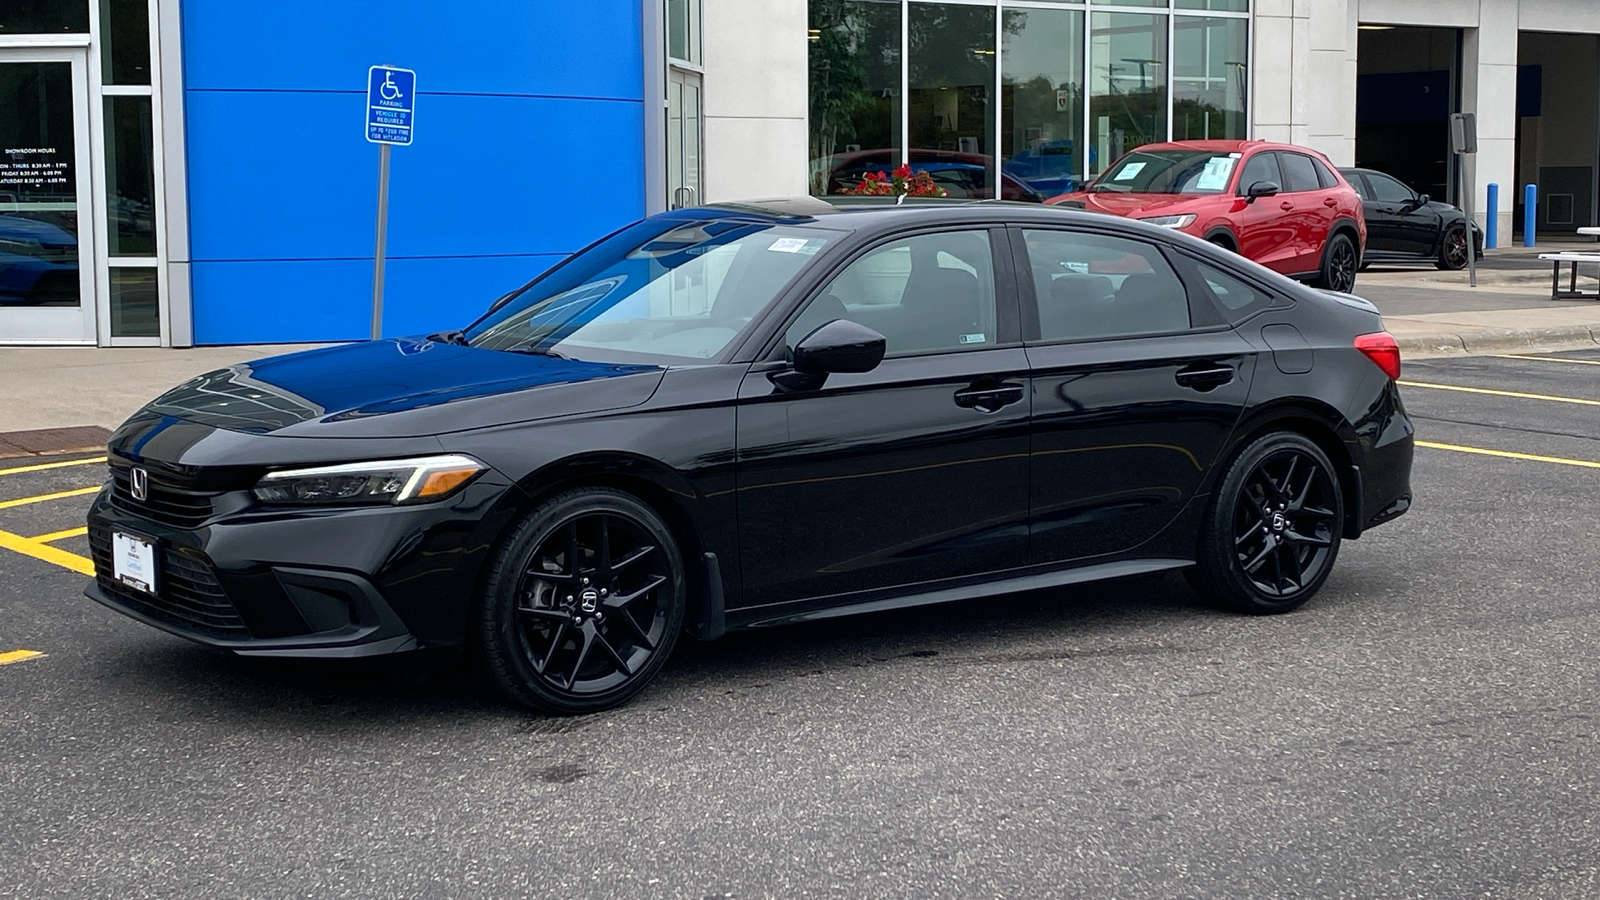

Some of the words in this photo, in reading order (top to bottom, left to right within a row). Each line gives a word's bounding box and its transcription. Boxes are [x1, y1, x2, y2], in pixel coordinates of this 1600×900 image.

[379, 100, 403, 108] PARKING
[375, 110, 398, 118] VEHICLE
[376, 117, 404, 125] REQUIRED
